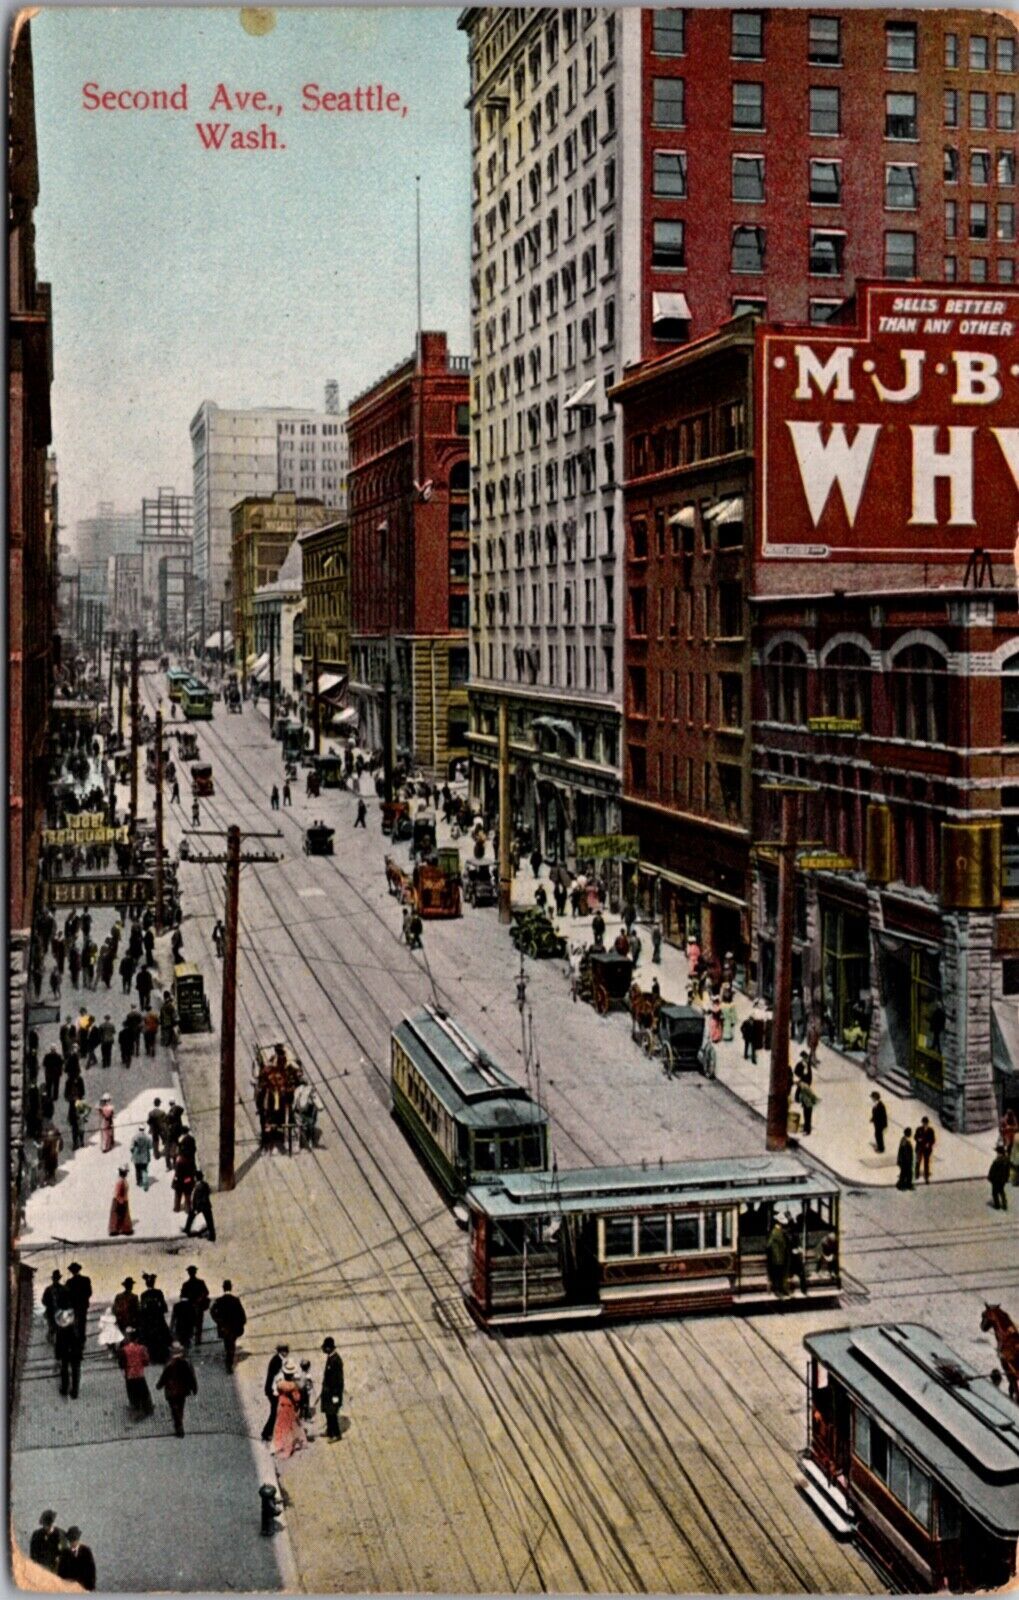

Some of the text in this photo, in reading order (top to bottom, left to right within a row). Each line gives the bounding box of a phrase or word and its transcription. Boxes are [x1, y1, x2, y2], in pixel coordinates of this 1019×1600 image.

[893, 298, 1005, 314] SELLS BETTER
[879, 316, 1014, 336] THAN ANY OTHER
[54, 881, 147, 902] BUTLER
